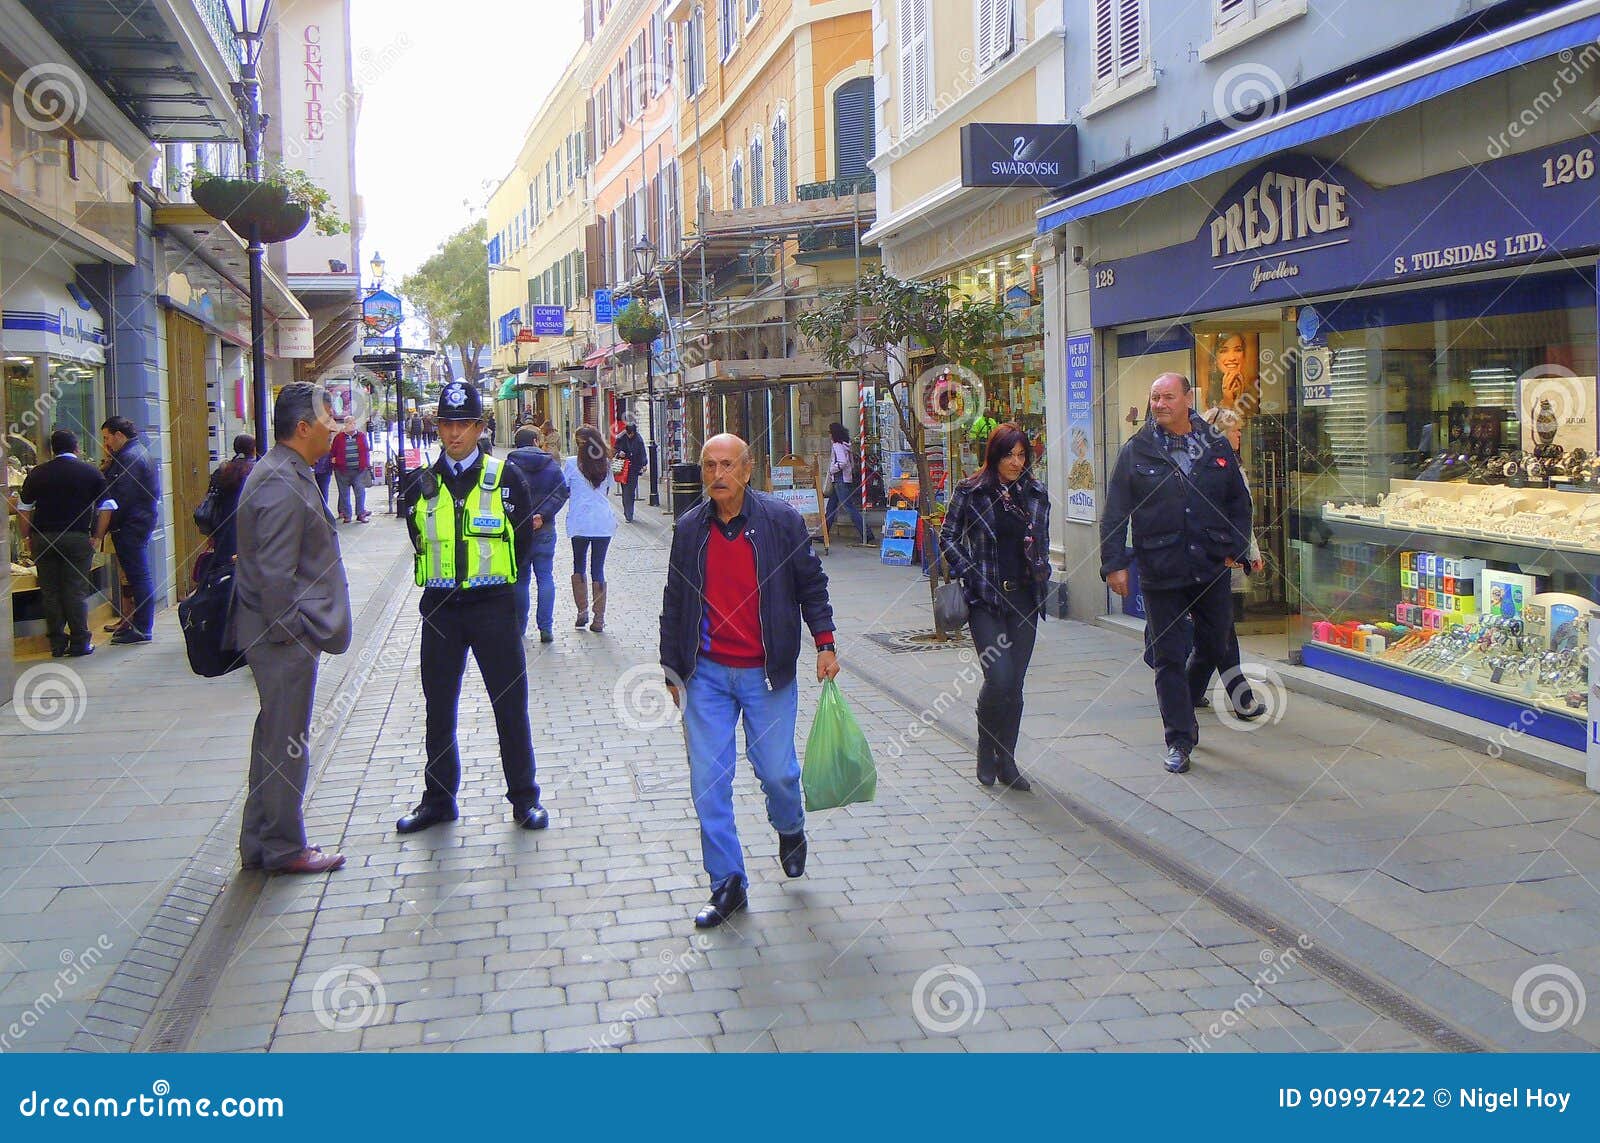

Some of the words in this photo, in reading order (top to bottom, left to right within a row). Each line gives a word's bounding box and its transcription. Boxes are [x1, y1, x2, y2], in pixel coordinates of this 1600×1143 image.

[304, 24, 325, 140] CENTRE
[991, 160, 1059, 176] SWAROVSKI
[1542, 149, 1595, 188] 126
[1210, 171, 1350, 257] PRESTIGE
[1394, 256, 1408, 274] S.
[1412, 240, 1496, 271] TULSIDAS
[1504, 232, 1547, 256] LTD.
[1095, 268, 1115, 289] 128
[1249, 260, 1298, 292] Jewellers
[537, 308, 561, 316] COHEN
[1069, 344, 1077, 355] WE
[1078, 343, 1089, 354] BUY
[1071, 355, 1087, 367] GOLD
[1304, 386, 1326, 399] 2012
[1069, 491, 1094, 507] PRESTIGE
[474, 519, 499, 527] POLICE
